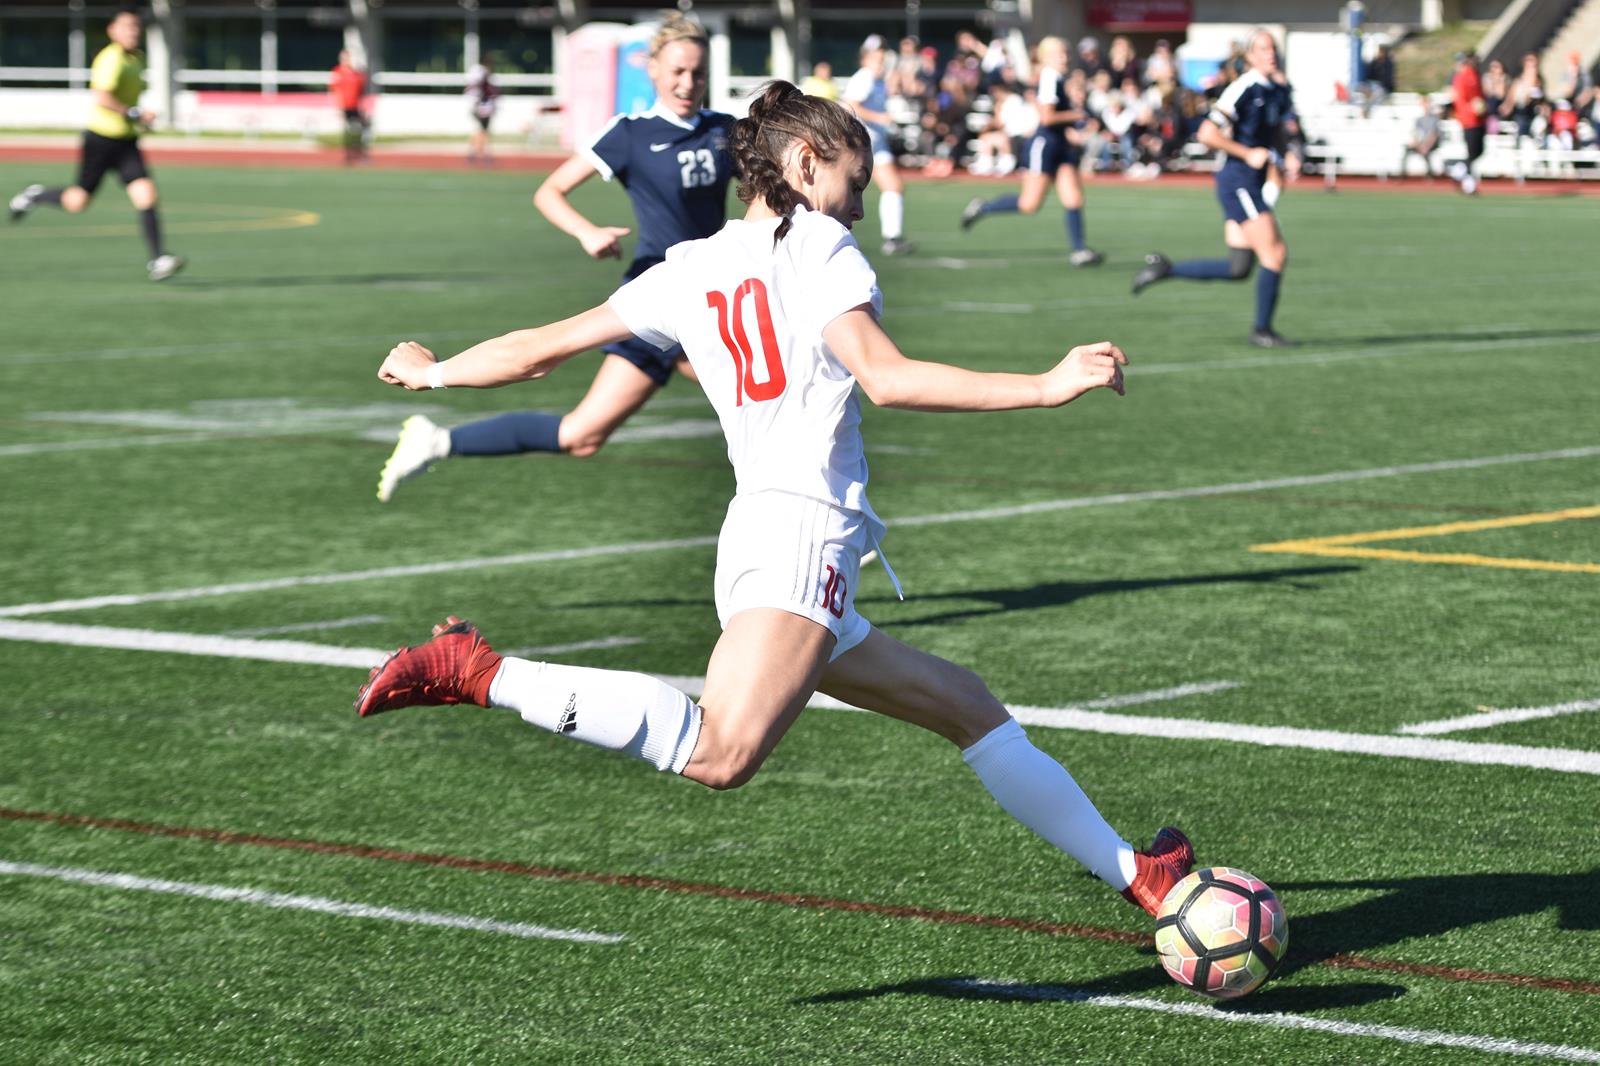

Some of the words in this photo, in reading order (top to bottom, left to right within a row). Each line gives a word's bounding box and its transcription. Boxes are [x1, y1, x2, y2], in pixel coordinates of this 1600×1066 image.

[677, 149, 716, 189] 23
[706, 278, 786, 407] 10
[822, 564, 847, 619] 10
